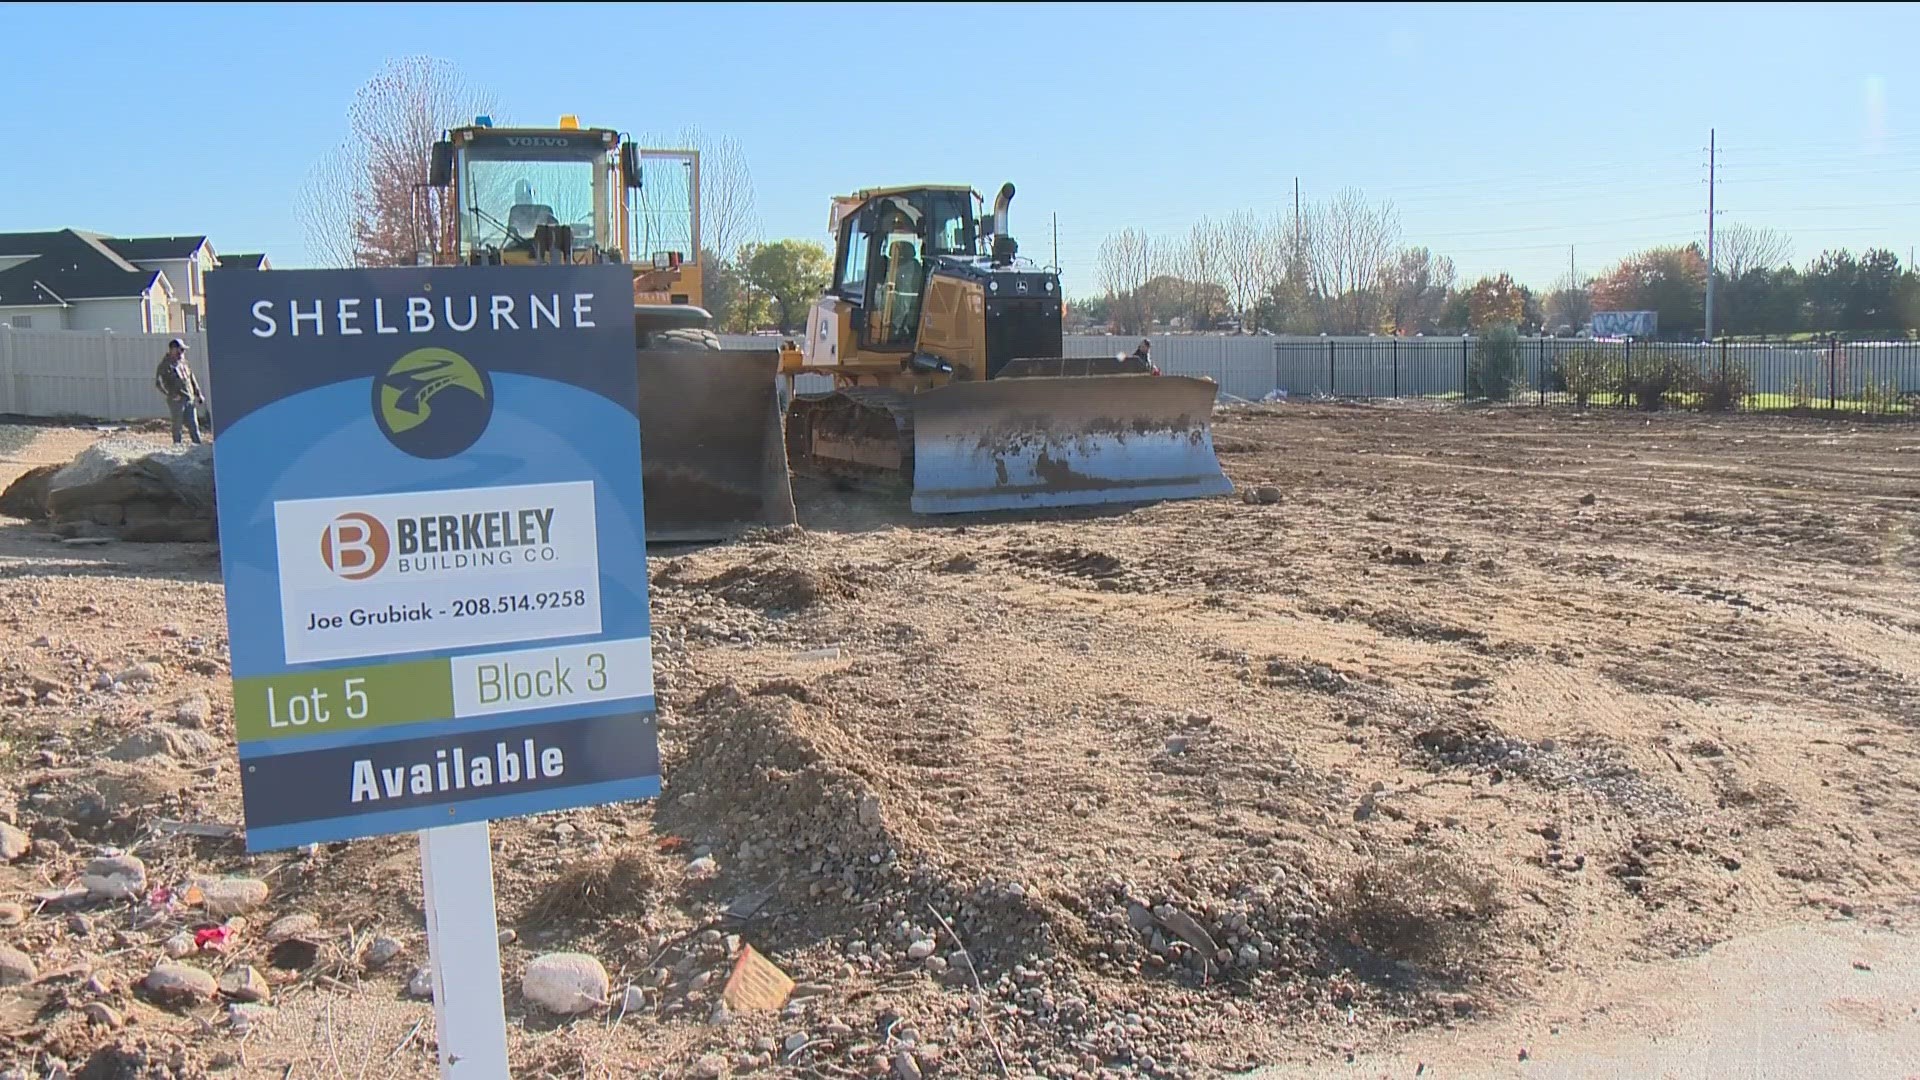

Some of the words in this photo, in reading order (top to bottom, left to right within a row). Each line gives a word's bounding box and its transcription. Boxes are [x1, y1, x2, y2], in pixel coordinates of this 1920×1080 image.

[507, 136, 568, 147] VOLVO
[252, 293, 596, 338] SHELBURNE
[331, 518, 376, 575] B
[397, 508, 555, 554] BERKELEY
[399, 549, 513, 573] BUILDING
[524, 547, 559, 563] CO.
[307, 611, 343, 631] Joe
[349, 602, 433, 626] Grubiak
[453, 589, 586, 617] 208.514.9258
[478, 657, 573, 704] Block
[587, 653, 607, 690] 3
[267, 687, 330, 728] Lot
[344, 678, 368, 717] 5
[350, 739, 565, 803] Available
